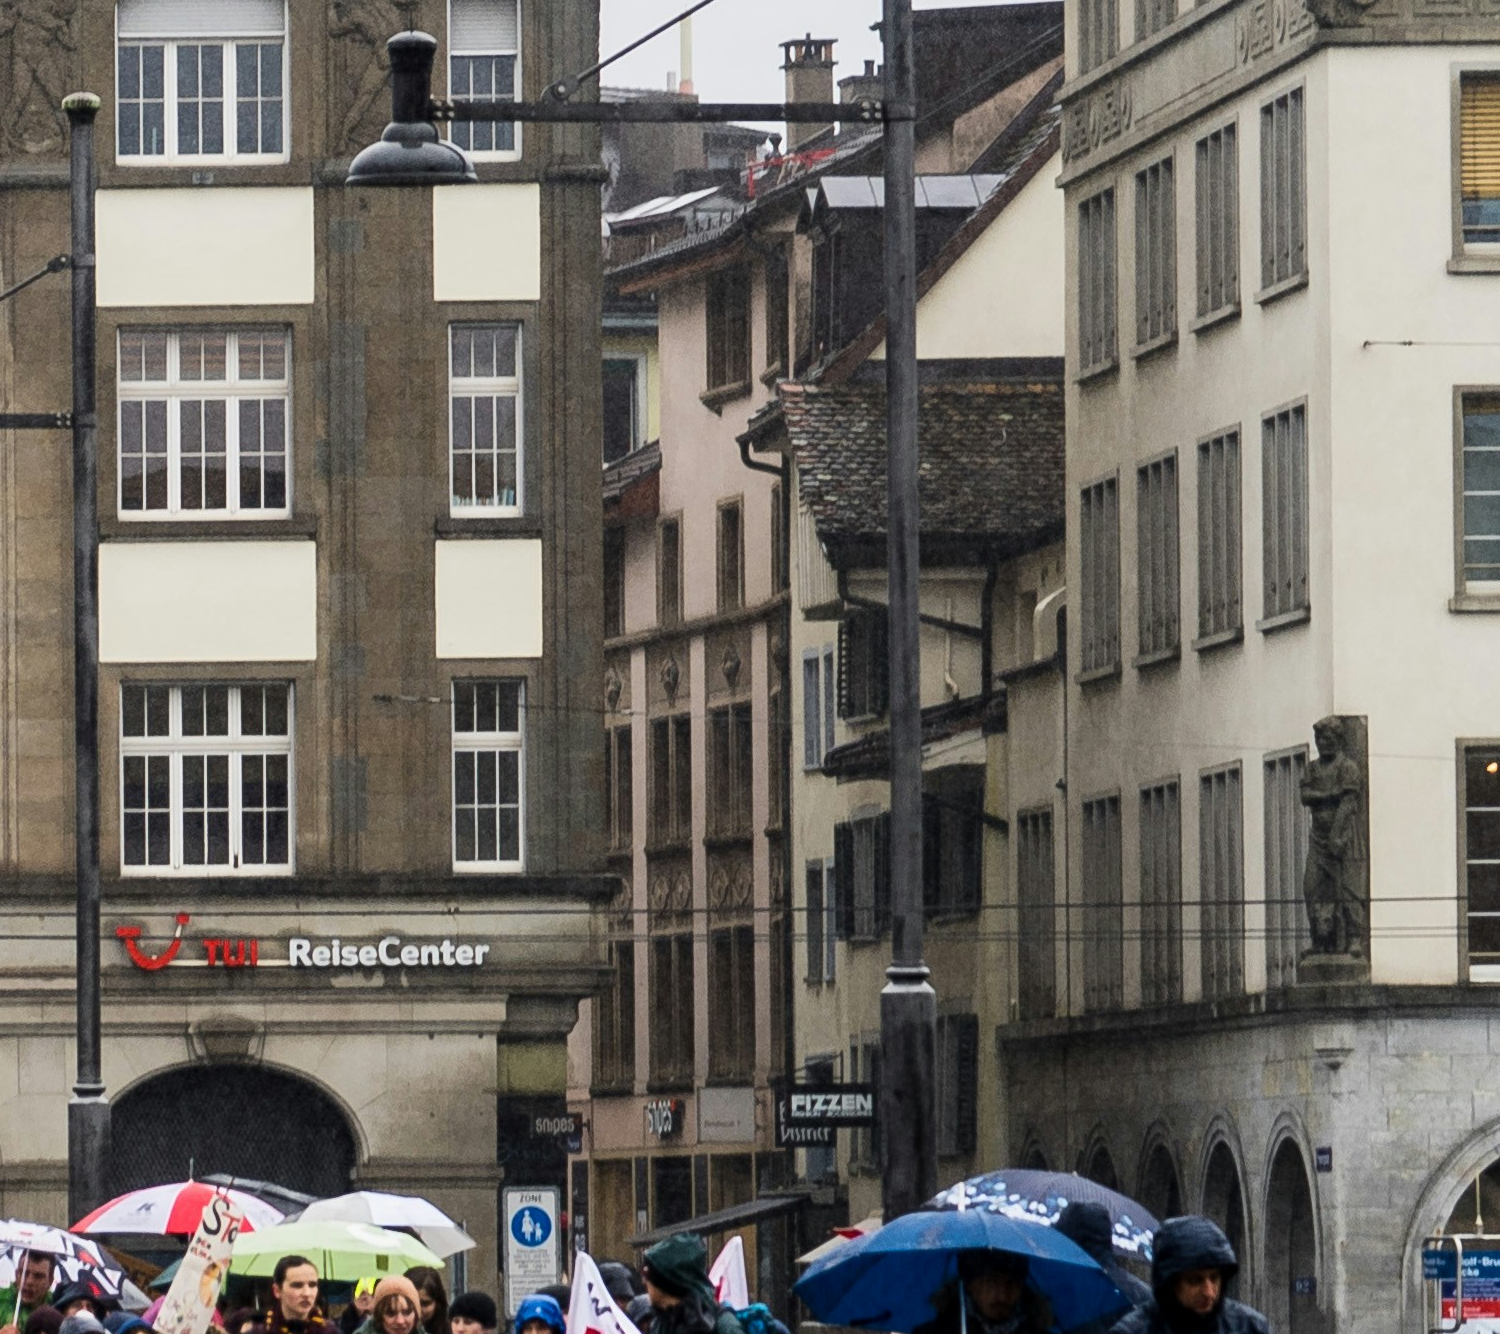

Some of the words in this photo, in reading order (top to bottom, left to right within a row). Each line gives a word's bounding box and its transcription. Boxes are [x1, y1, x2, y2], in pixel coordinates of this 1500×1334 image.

[203, 939, 259, 966] TUI
[288, 937, 490, 967] ReiseCenter
[791, 1094, 872, 1111] FIZZEN
[536, 1117, 575, 1136] snipes
